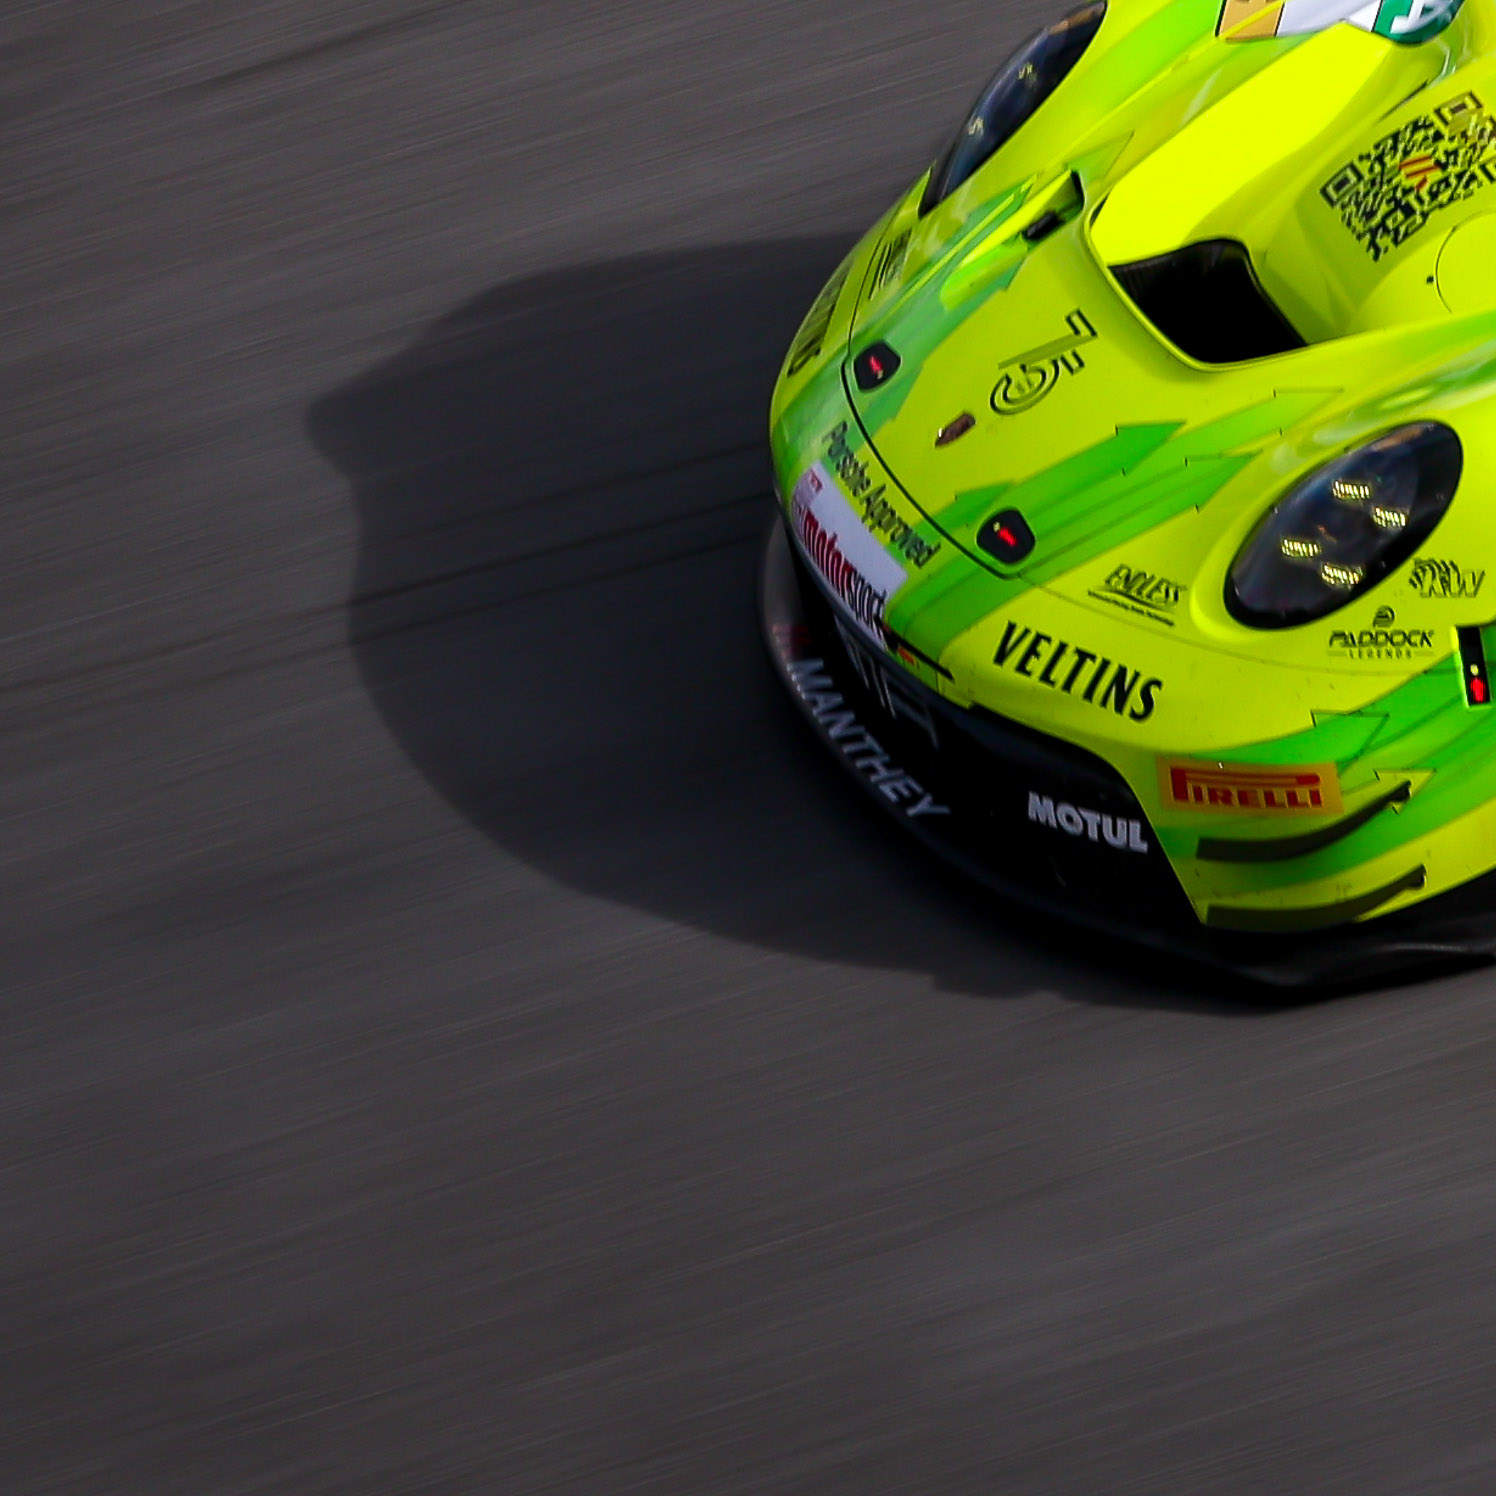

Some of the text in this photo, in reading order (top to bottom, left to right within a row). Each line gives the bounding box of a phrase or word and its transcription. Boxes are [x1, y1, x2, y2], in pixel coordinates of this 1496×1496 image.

[1329, 629, 1435, 648] PADDOCK
[993, 621, 1163, 723] VELTINS
[786, 658, 951, 818] MANTHEY
[1169, 767, 1323, 808] PIRELLI
[1028, 790, 1149, 854] MOTUL
